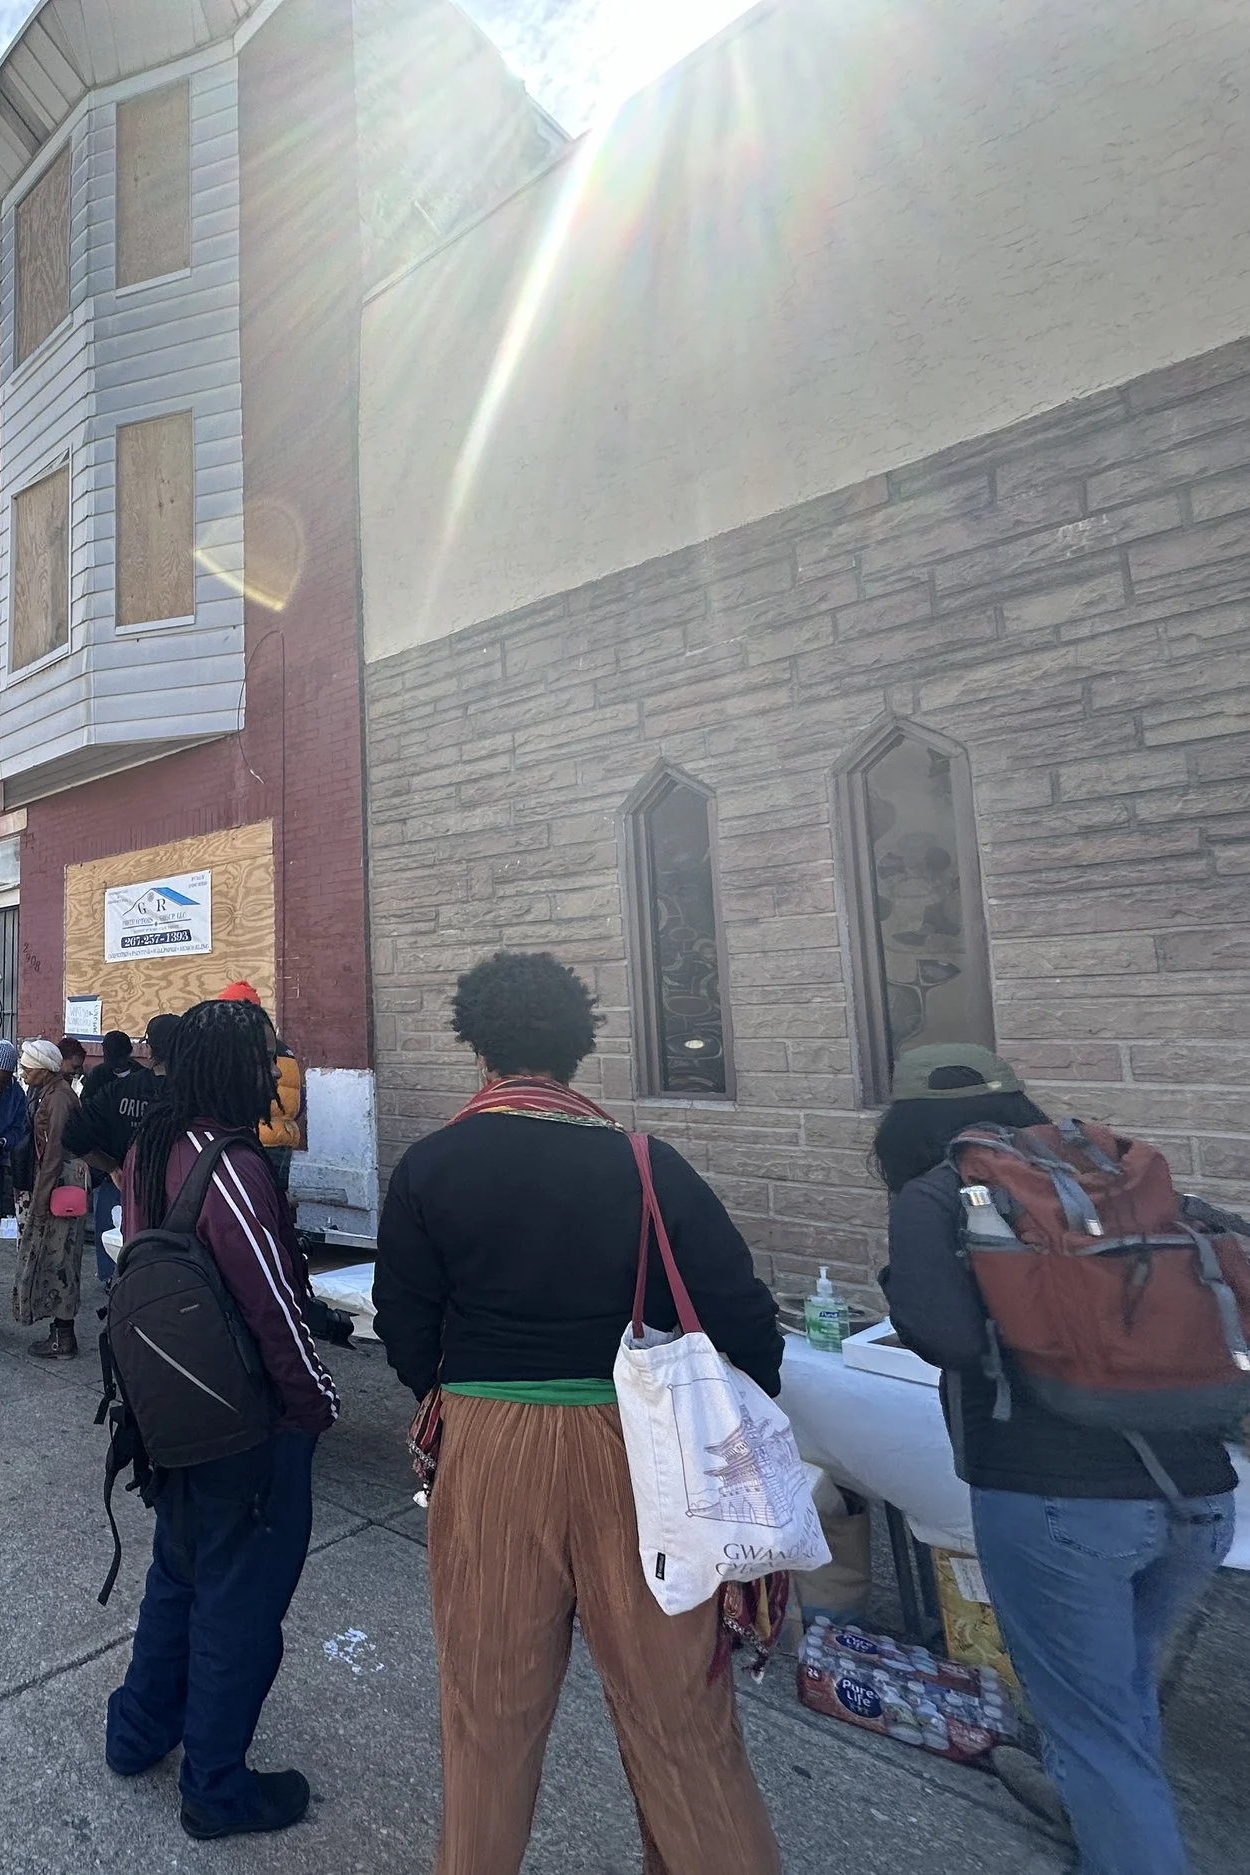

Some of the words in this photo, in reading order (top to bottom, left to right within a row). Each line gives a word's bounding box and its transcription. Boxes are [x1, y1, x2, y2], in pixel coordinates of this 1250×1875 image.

[157, 898, 166, 912] R
[842, 1680, 874, 1698] Pure
[847, 1691, 871, 1707] Life
